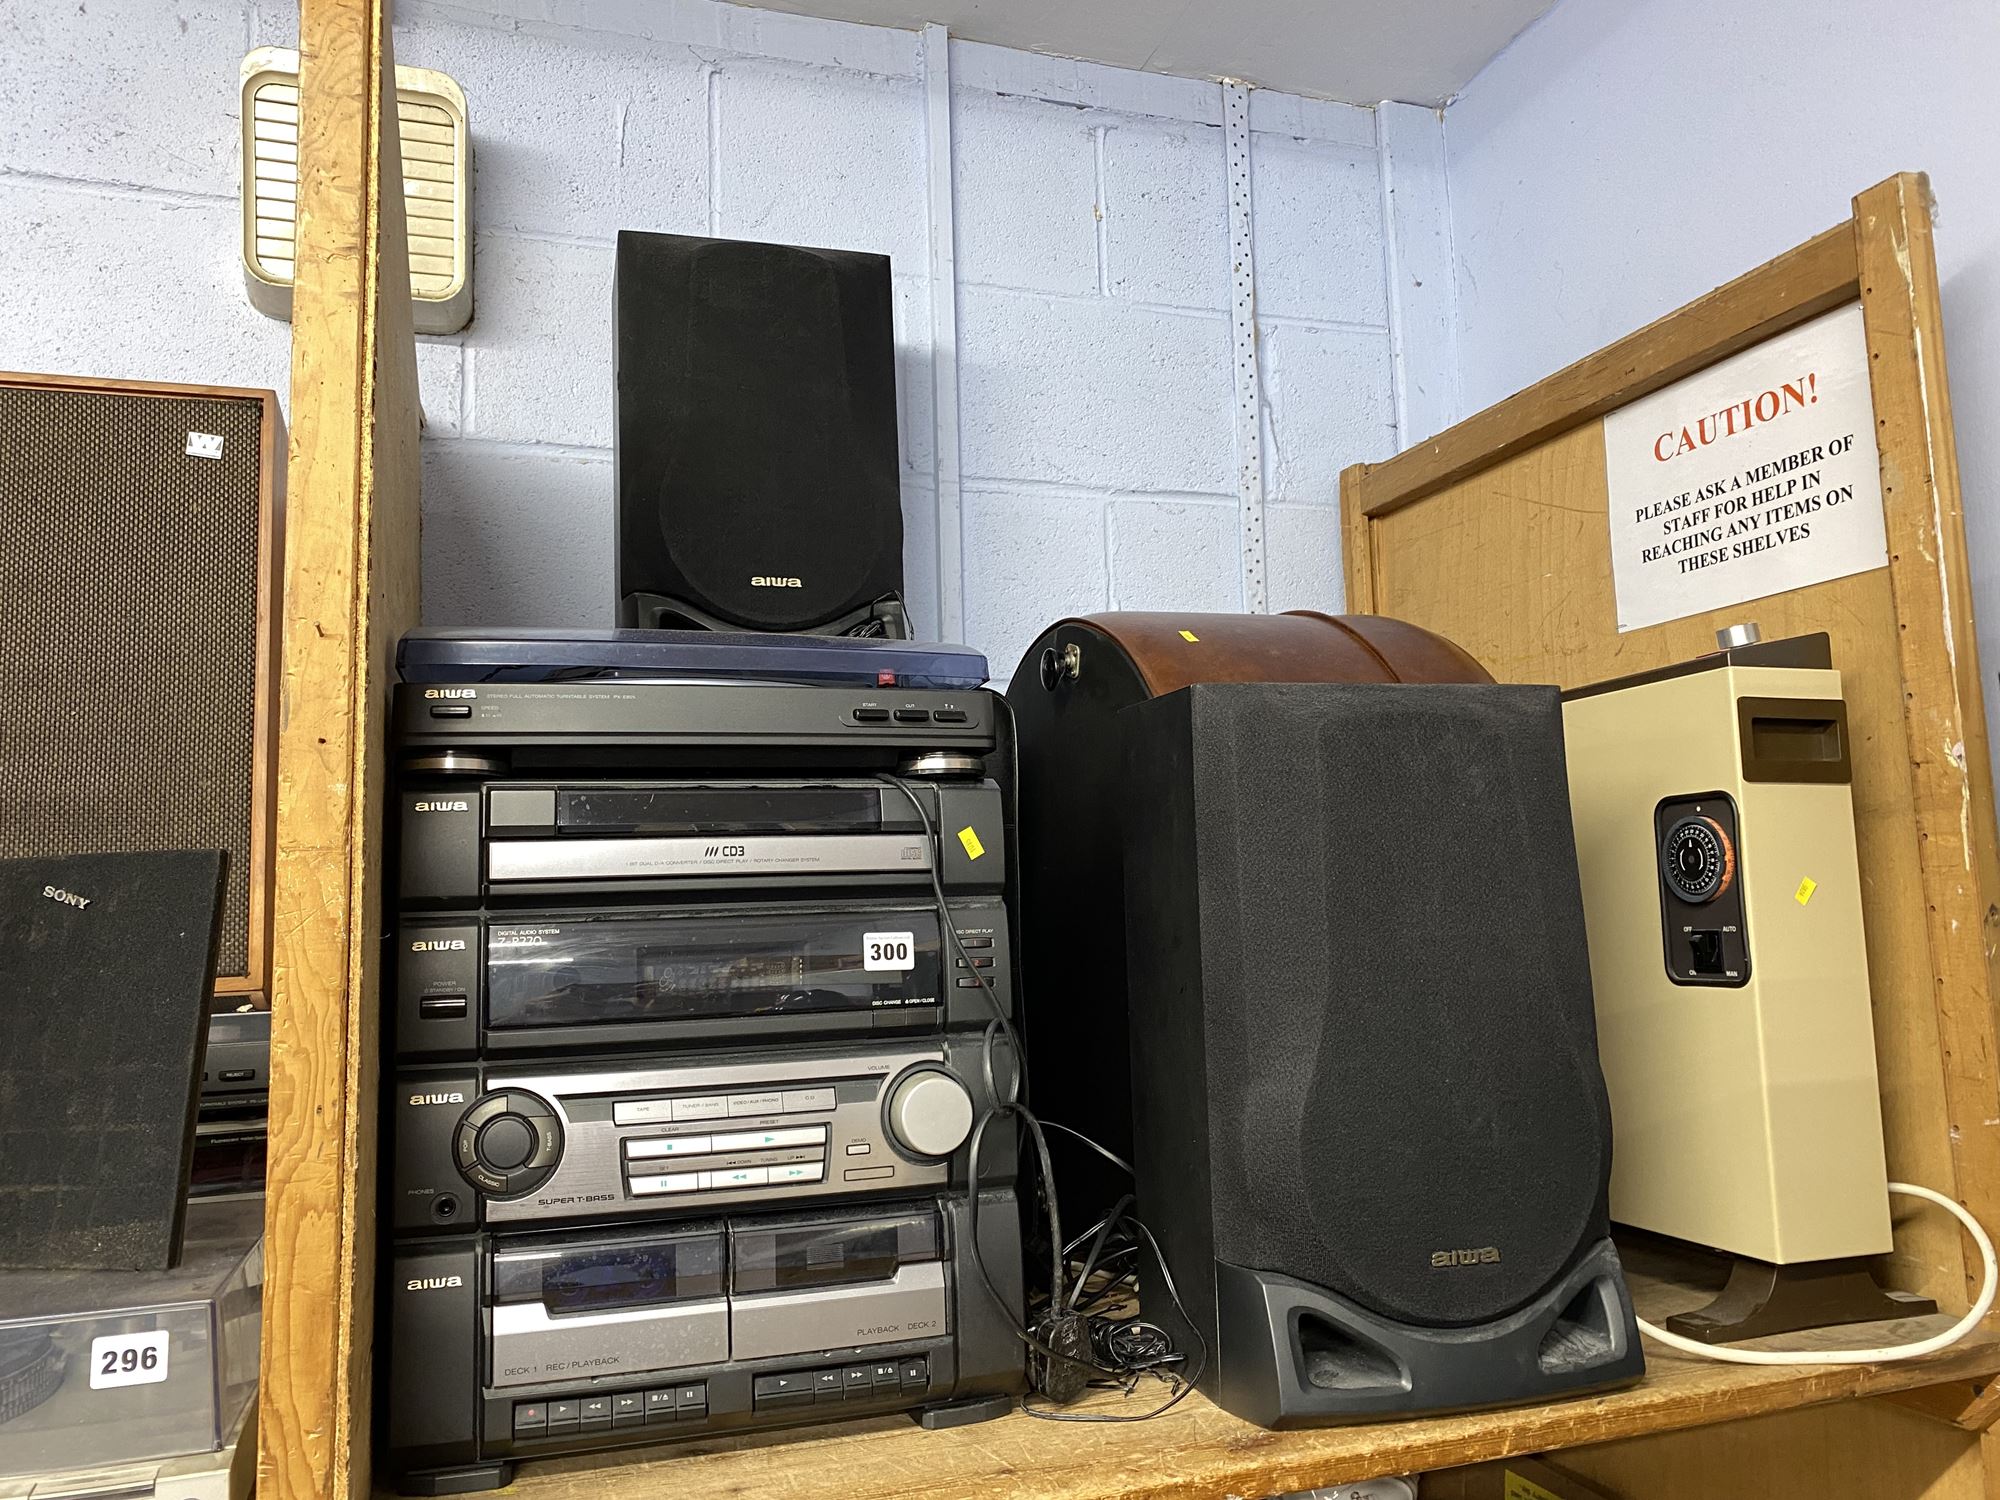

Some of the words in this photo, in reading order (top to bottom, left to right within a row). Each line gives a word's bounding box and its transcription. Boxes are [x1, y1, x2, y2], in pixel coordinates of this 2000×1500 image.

[1653, 373, 1818, 462] CAUTION!
[1635, 492, 1691, 523] PLEASE
[1695, 479, 1726, 504] ASK
[1730, 476, 1741, 490] A
[1745, 446, 1824, 485] MEMBER
[1828, 434, 1855, 456] OF
[1663, 508, 1711, 535] STAFF
[1714, 495, 1747, 519] FOR
[1752, 478, 1797, 508] HELP
[1802, 470, 1821, 490] IN
[1641, 526, 1723, 563] REACHING
[1726, 514, 1761, 538] ANY
[1765, 496, 1821, 526] ITEMS
[1825, 485, 1854, 506] ON
[1678, 547, 1729, 574] THESE
[1732, 523, 1810, 559] SHELVES
[750, 576, 802, 588] aiwa
[425, 689, 477, 699] aiwa
[415, 801, 469, 812] aiwa
[722, 845, 745, 857] CD3
[43, 885, 91, 910] SONY
[412, 940, 466, 951] aiwa
[870, 943, 908, 961] 300
[409, 1092, 464, 1106] aiwa
[478, 1174, 500, 1188] CLASSIC
[408, 1188, 434, 1196] PHONES
[537, 1196, 575, 1206] SUPER
[577, 1194, 615, 1203] T-BASS
[1431, 1247, 1501, 1267] aiwa
[407, 1276, 463, 1291] aiwa
[857, 1324, 900, 1337] PLAYBACK
[907, 1321, 930, 1330] DECK
[931, 1320, 937, 1328] 2
[101, 1346, 158, 1375] 296
[504, 1366, 530, 1376] DECK
